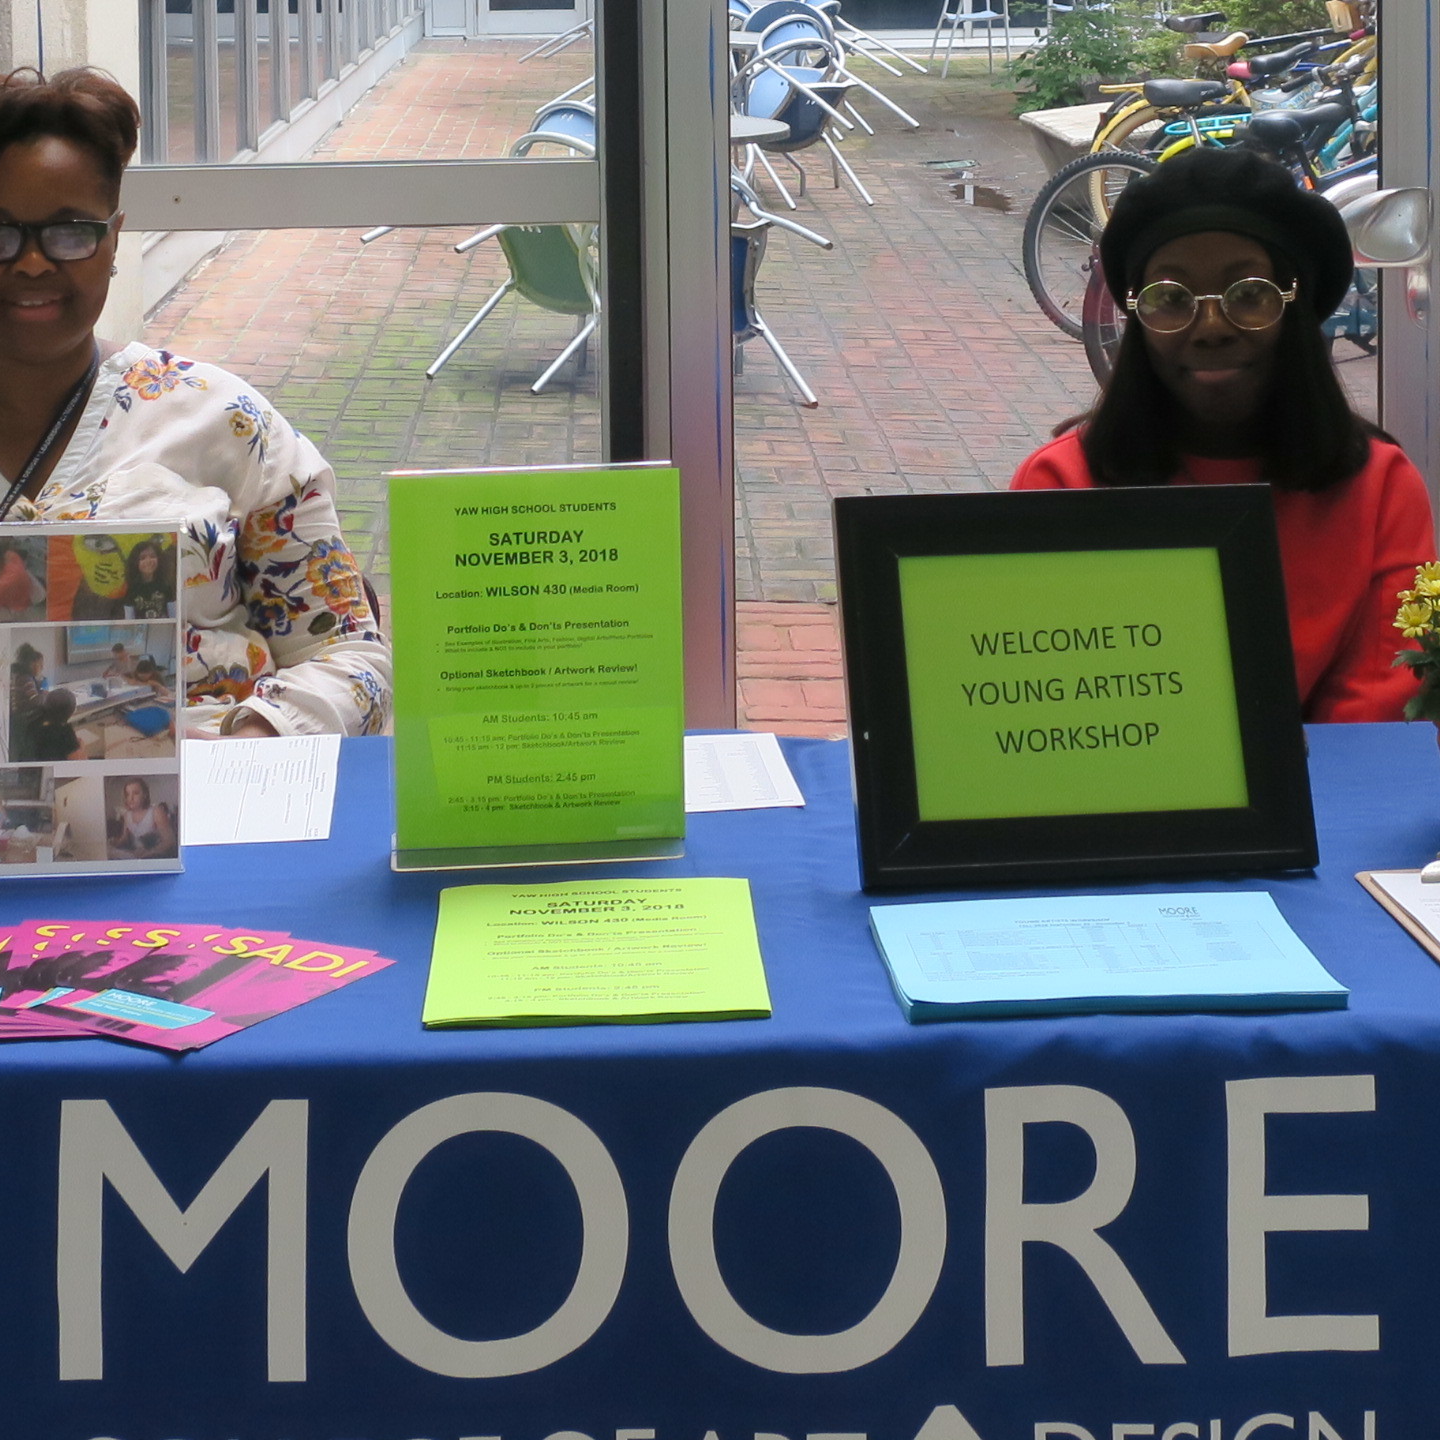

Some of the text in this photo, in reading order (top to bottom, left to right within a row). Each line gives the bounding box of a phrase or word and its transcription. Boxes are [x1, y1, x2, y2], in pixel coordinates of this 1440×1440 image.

[455, 502, 616, 516] YAW HIGH SCHOOL STUDENTS
[489, 530, 583, 546] SATURDAY
[455, 548, 618, 567] NOVEMBER 3, 2018
[436, 583, 638, 599] Location: WILSON 430 (Media Room)
[447, 625, 490, 634] Portfolio
[494, 623, 516, 632] Do's
[519, 623, 526, 631] &
[565, 620, 629, 629] Presentation
[970, 622, 1163, 657] WELCOME TO
[441, 670, 483, 681] Optional
[486, 668, 545, 678] Sketchbook
[555, 666, 594, 675] Artwork
[598, 664, 637, 673] Review!
[960, 670, 1183, 707] YOUNG ARTISTS
[482, 712, 597, 724] AM Students: 10:45 am
[995, 721, 1160, 755] WORKSHOP
[487, 773, 596, 784] PM Students: 2:45 pm
[510, 906, 614, 915] NOVEMBER
[548, 898, 647, 908] SATURDAY
[1158, 906, 1199, 916] MOORE
[212, 935, 371, 979] SADI
[56, 1072, 1381, 1383] MOORE
